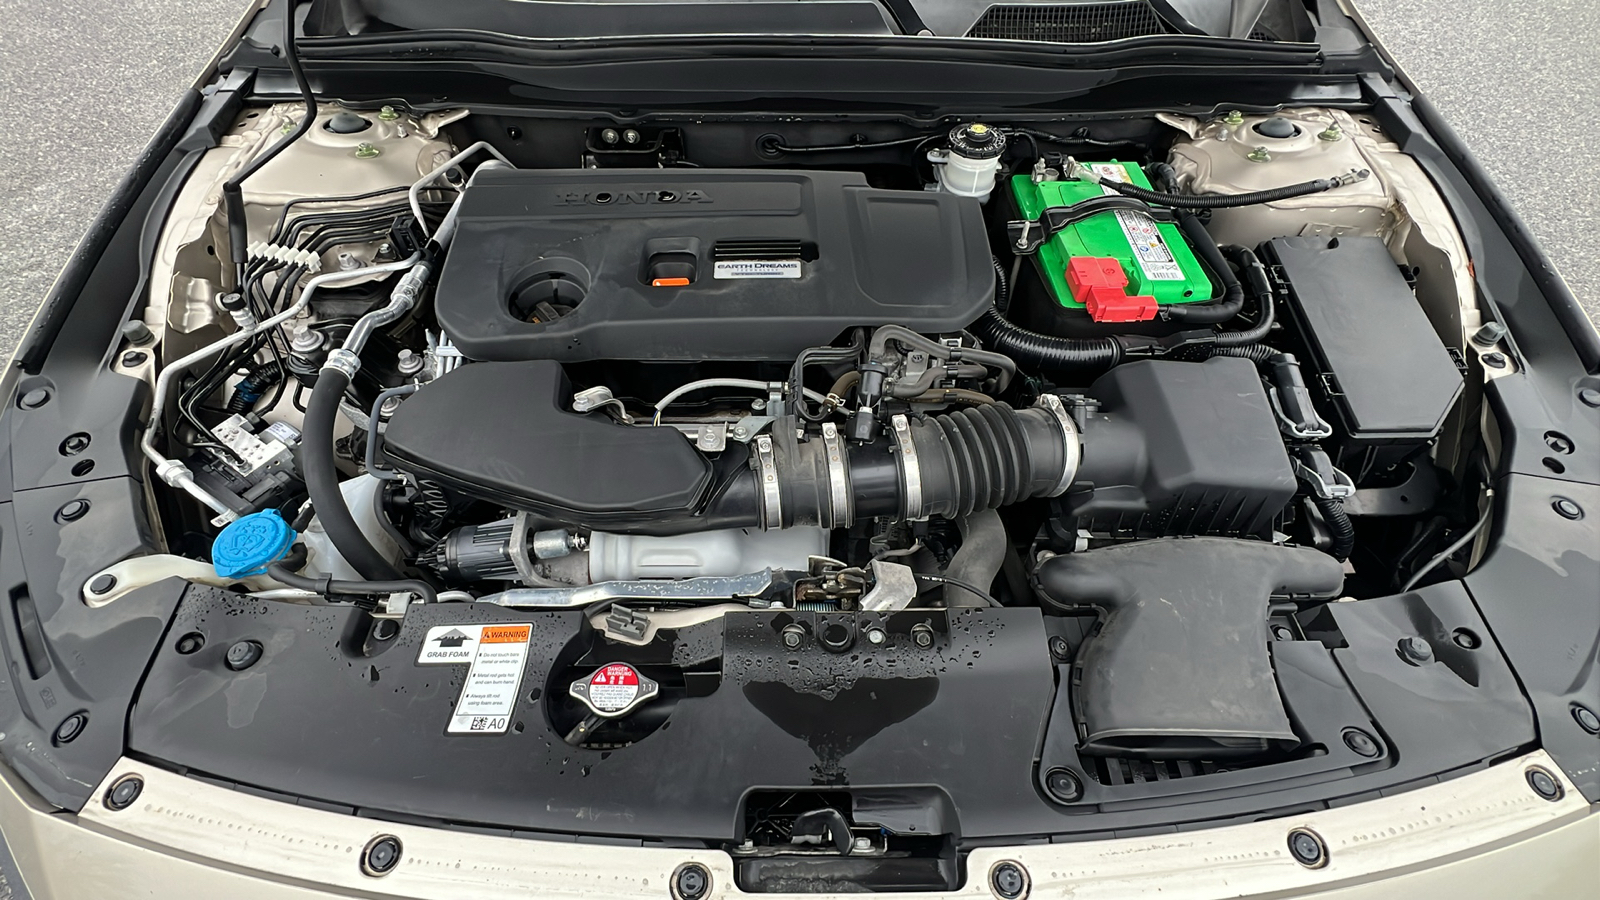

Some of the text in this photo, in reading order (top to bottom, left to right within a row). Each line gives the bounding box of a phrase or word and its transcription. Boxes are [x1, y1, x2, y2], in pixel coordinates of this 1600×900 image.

[553, 189, 714, 206] HONDA
[491, 630, 527, 639] WARNING
[487, 718, 505, 730] A0
